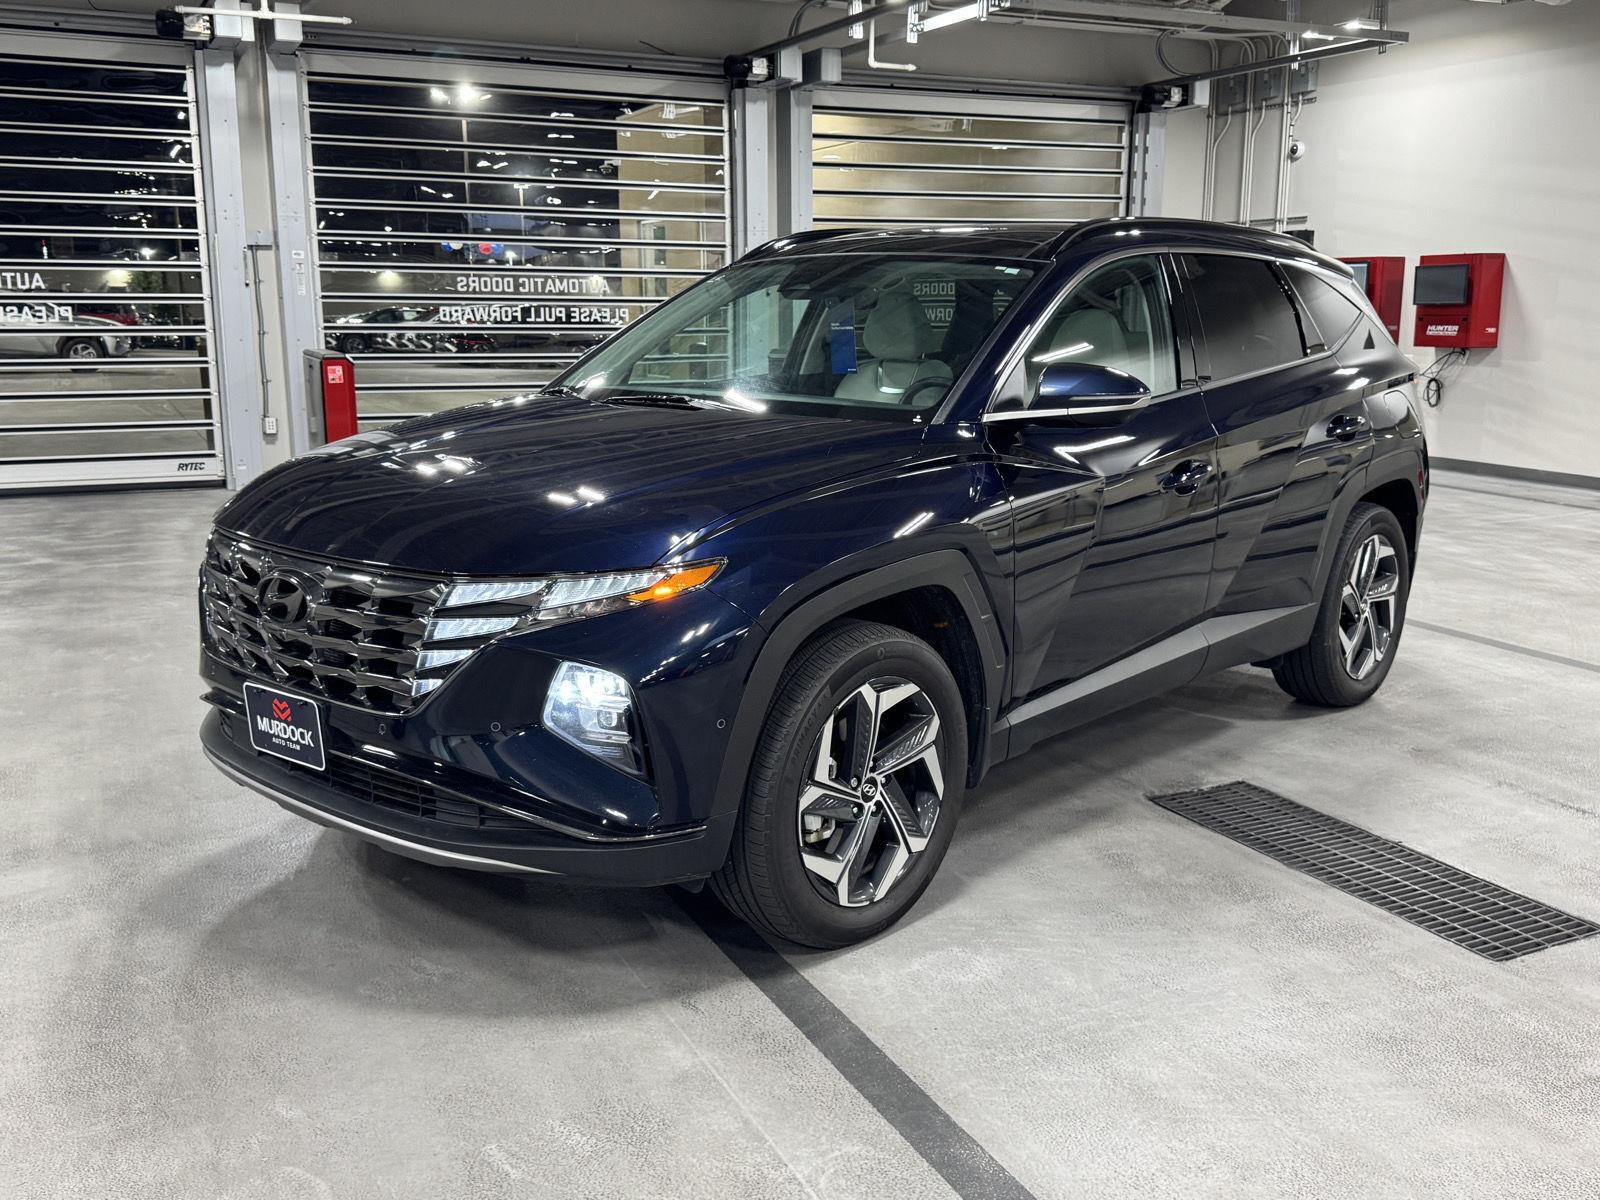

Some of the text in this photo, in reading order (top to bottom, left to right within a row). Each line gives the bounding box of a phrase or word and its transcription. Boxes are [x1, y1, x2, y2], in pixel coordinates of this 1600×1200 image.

[177, 462, 206, 471] RYTEC
[256, 715, 315, 748] MURDOCK
[272, 737, 300, 751] AUTO TEAM
